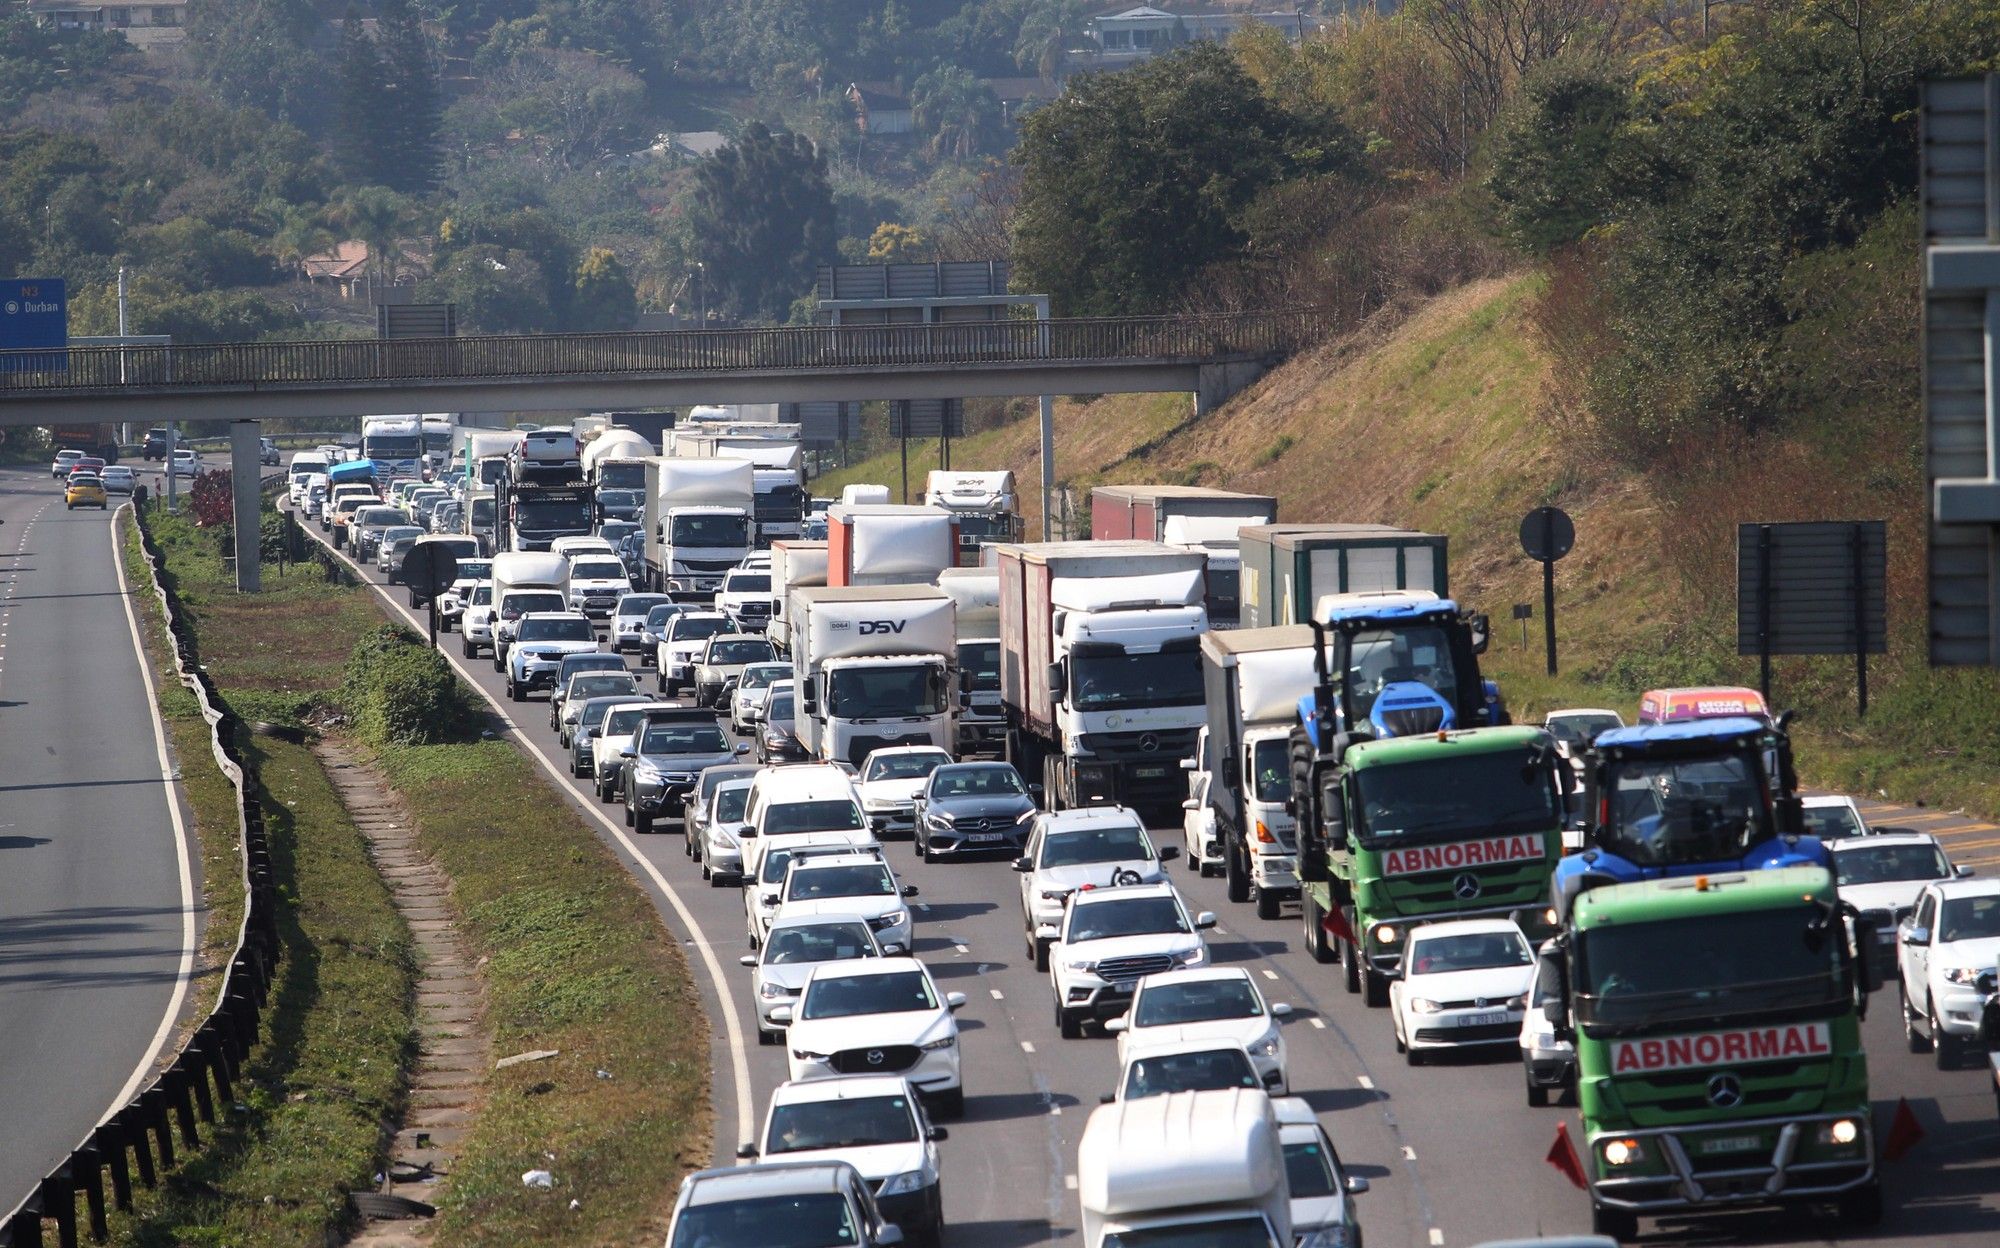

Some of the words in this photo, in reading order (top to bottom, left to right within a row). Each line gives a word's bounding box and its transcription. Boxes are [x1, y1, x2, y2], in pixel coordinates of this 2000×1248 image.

[22, 286, 39, 297] N3
[25, 302, 58, 313] Durban
[859, 619, 907, 635] DSV
[1385, 834, 1543, 875] ABNORMAL
[1616, 1025, 1828, 1072] ABNORMAL
